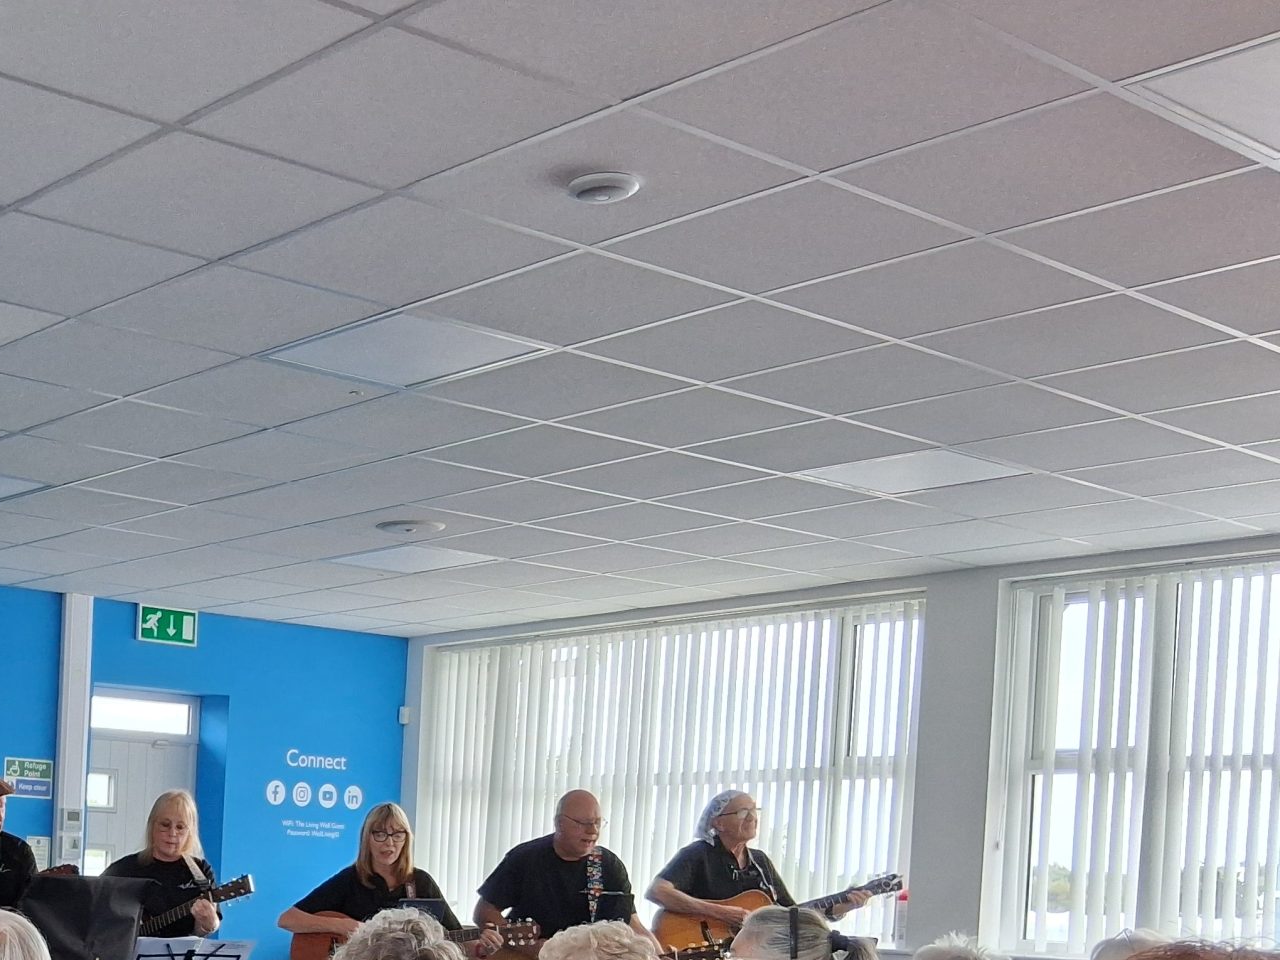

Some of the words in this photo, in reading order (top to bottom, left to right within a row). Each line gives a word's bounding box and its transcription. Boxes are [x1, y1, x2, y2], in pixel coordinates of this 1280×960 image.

[286, 749, 347, 770] Connect
[24, 762, 47, 771] Refuge
[24, 770, 40, 778] Point
